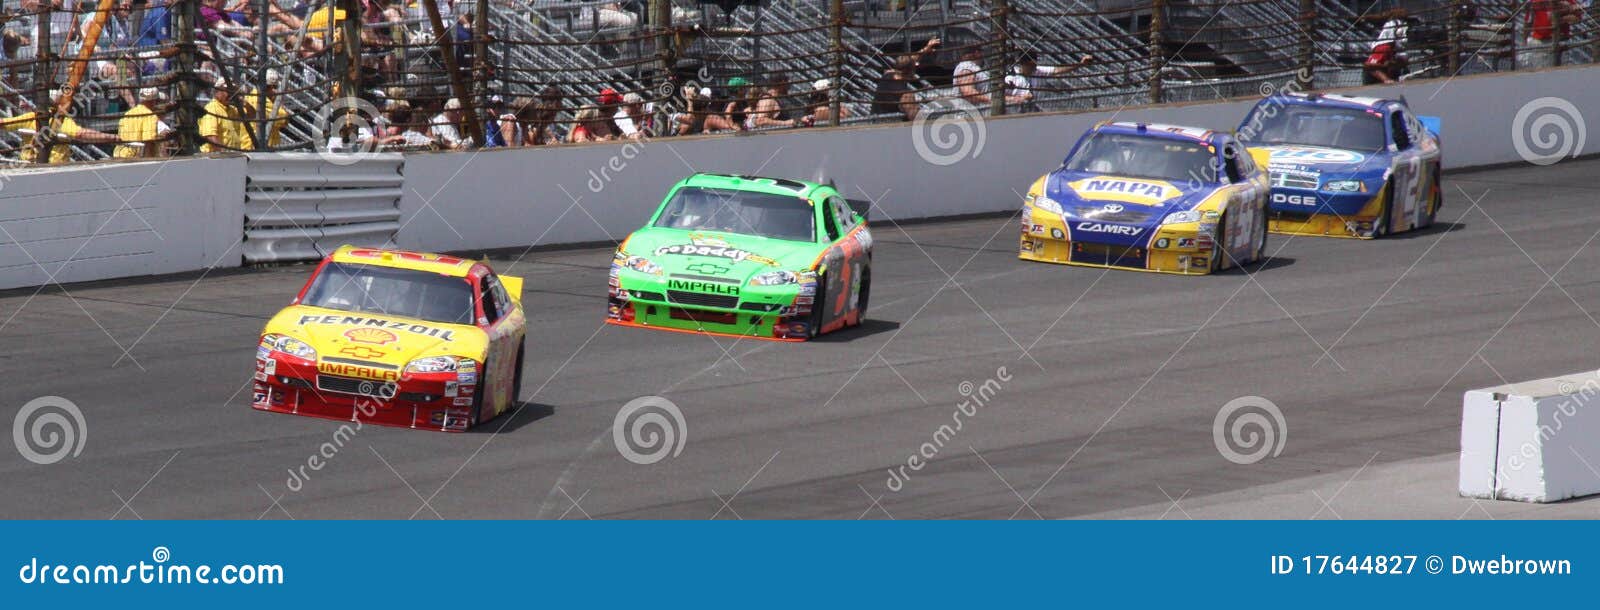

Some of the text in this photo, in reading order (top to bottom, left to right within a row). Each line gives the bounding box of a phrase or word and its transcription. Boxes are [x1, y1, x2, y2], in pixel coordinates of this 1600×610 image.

[1085, 179, 1164, 198] NAPA
[1269, 193, 1317, 206] DGE
[1076, 222, 1143, 236] CAMRY
[668, 279, 740, 295] IMPALA
[299, 315, 456, 341] PENNZOIL
[319, 362, 398, 381] IMPALA
